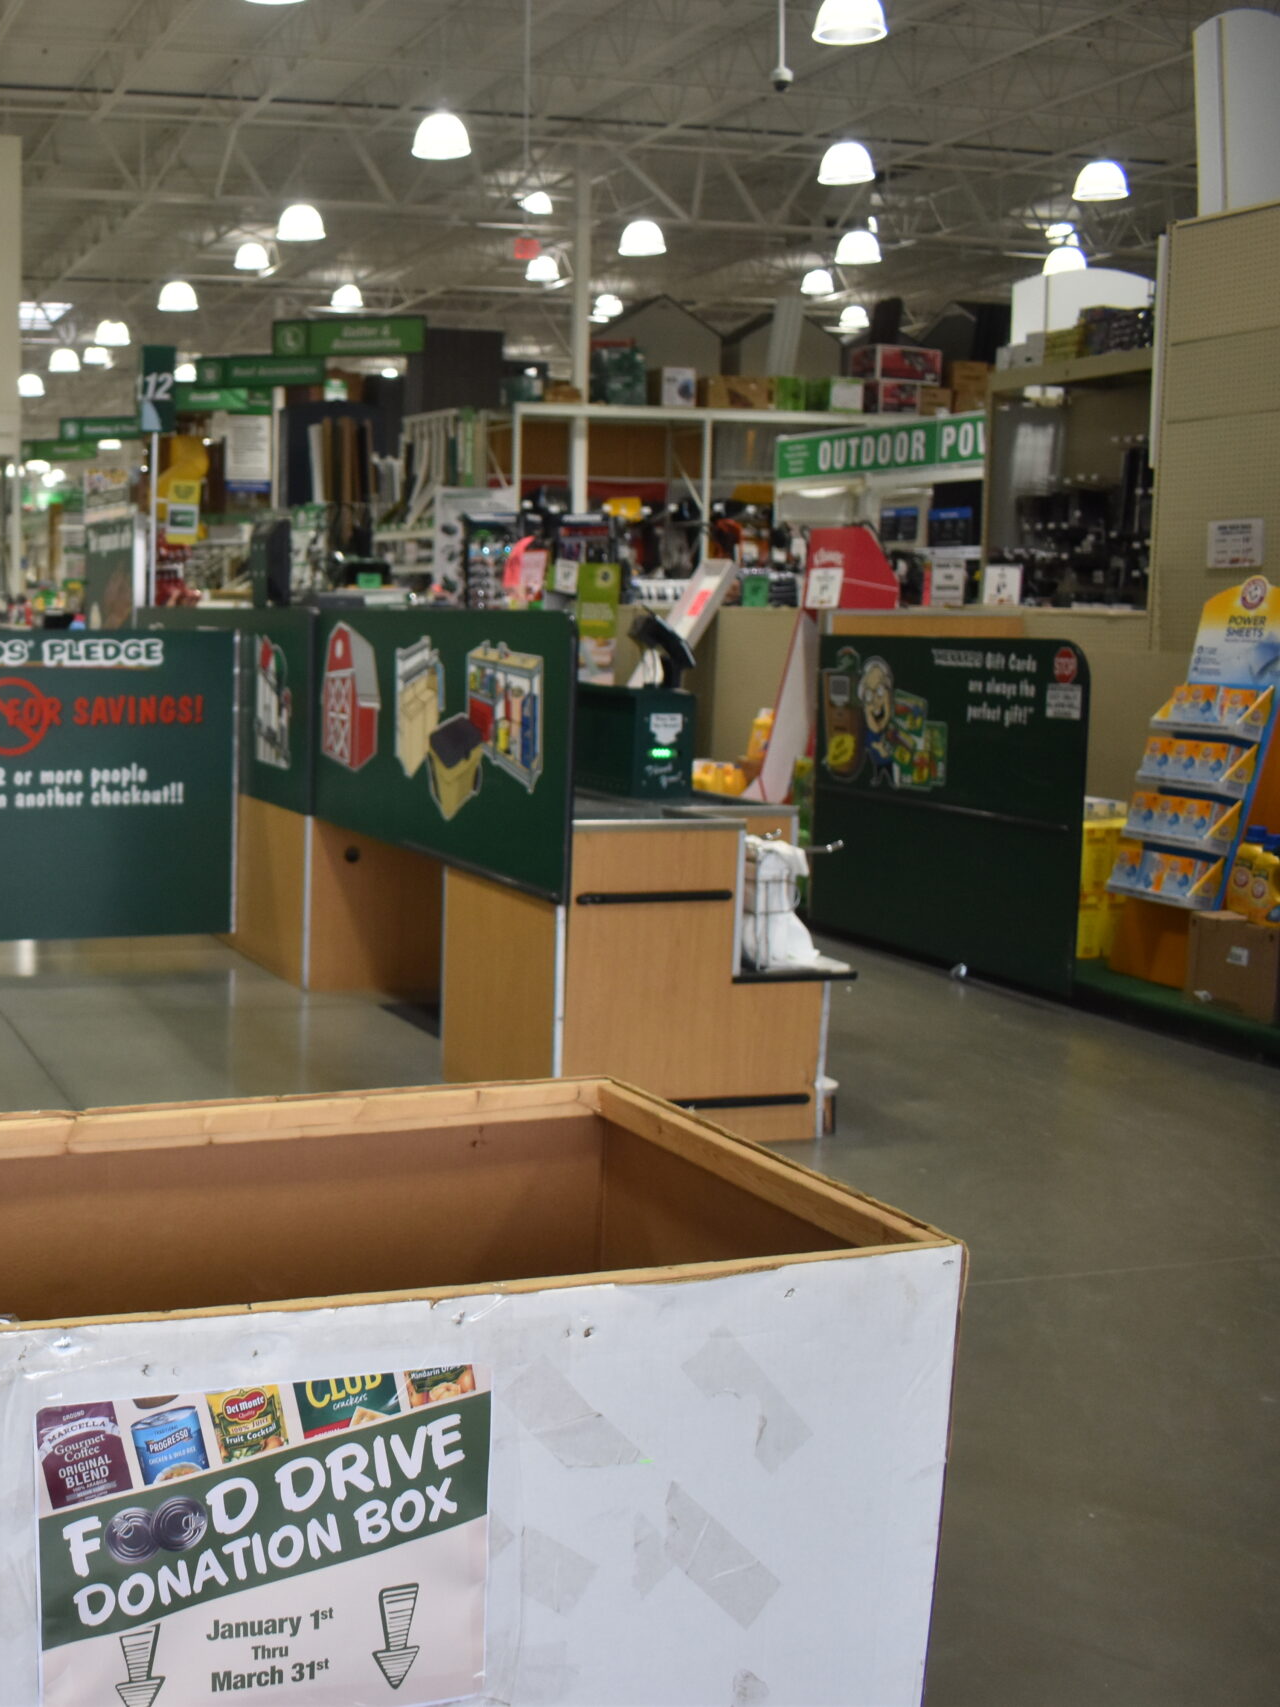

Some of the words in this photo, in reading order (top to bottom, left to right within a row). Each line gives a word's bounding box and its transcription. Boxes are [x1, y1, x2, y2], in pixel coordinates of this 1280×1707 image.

[143, 371, 175, 400] 12
[817, 429, 926, 472] OUTDOOR
[1228, 615, 1267, 626] POWER
[1225, 627, 1264, 638] SHEETS
[42, 638, 163, 667] PLEDGE
[985, 651, 1006, 671] Gift
[1008, 653, 1037, 673] Cards
[1054, 657, 1078, 675] STOP
[968, 679, 983, 693] are
[986, 677, 1017, 699] always
[1019, 679, 1036, 698] the
[6, 697, 62, 727] FOR
[73, 695, 204, 726] SAVINGS!
[967, 702, 1001, 723] perfect
[13, 769, 32, 787] or
[40, 768, 83, 786] more
[90, 763, 147, 788] people
[14, 788, 84, 808] another
[90, 782, 184, 806] checkout!!
[410, 1367, 441, 1380] Mandarin
[305, 1373, 383, 1409] CLUB
[332, 1392, 369, 1412] crackers
[62, 1409, 85, 1422] GROUND
[225, 1404, 239, 1415] Del
[239, 1396, 265, 1411] Monte
[238, 1408, 257, 1419] Quality
[47, 1419, 107, 1444] MARCELLA
[148, 1428, 189, 1453] PROGRESSO
[225, 1435, 244, 1446] Fruit
[247, 1422, 277, 1441] Cocktail
[230, 1424, 250, 1435] 100%
[53, 1433, 106, 1456] Gourmet
[63, 1444, 101, 1463] Coffee
[58, 1453, 113, 1479] ORIGINAL
[148, 1454, 169, 1465] CHICKEN
[274, 1413, 466, 1513] DRIVE
[65, 1465, 110, 1489] BLEND
[72, 1512, 343, 1627] DONATION
[353, 1476, 458, 1545] BOX
[206, 1616, 302, 1641] January
[309, 1607, 334, 1630] 1st
[251, 1644, 289, 1660] Thru
[211, 1665, 284, 1693] March
[291, 1658, 330, 1683] 31st
